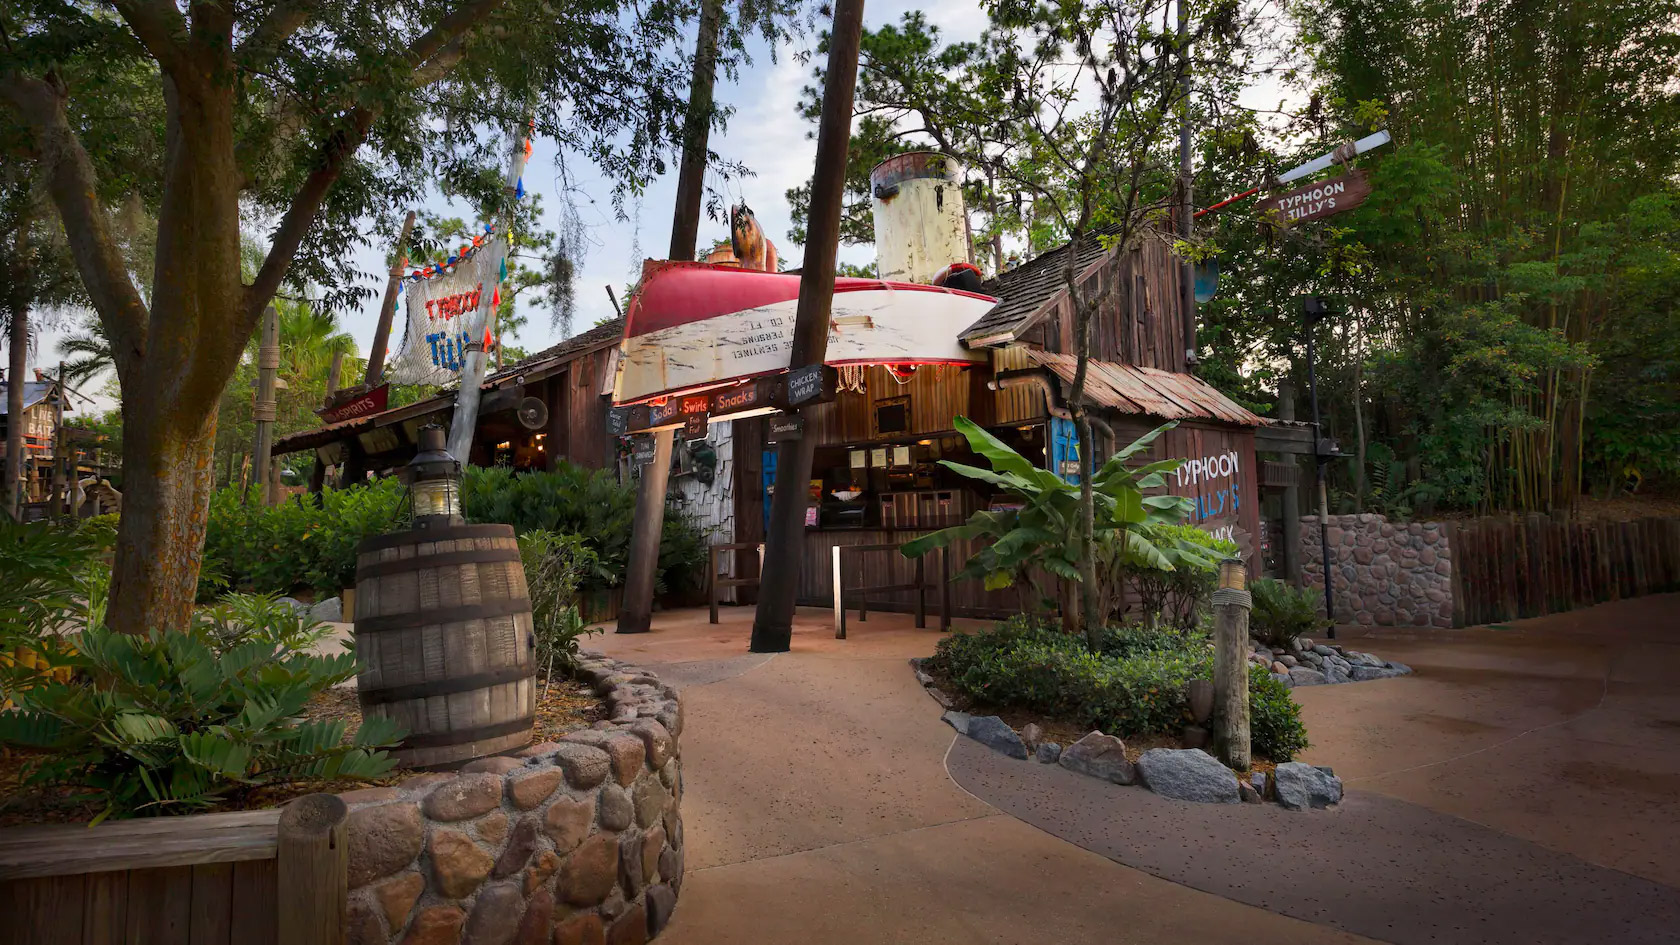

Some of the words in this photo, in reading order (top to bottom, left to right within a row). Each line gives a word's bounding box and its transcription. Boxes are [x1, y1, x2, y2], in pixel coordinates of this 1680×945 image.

[1278, 181, 1345, 210] TYPHOON
[1288, 198, 1336, 219] TILLY'S
[741, 331, 784, 345] PERSONS
[732, 343, 778, 359] SENTINEL
[790, 371, 818, 389] CHICKEN
[794, 383, 815, 398] WRAP
[338, 397, 376, 418] SPIRITS
[653, 406, 673, 420] Soda
[684, 400, 708, 414] Swirls
[719, 391, 754, 409] Snacks
[31, 407, 53, 422] LIVE
[28, 422, 52, 437] BAIT
[773, 422, 798, 433] Smoothies
[1176, 451, 1239, 488] TYPHOON
